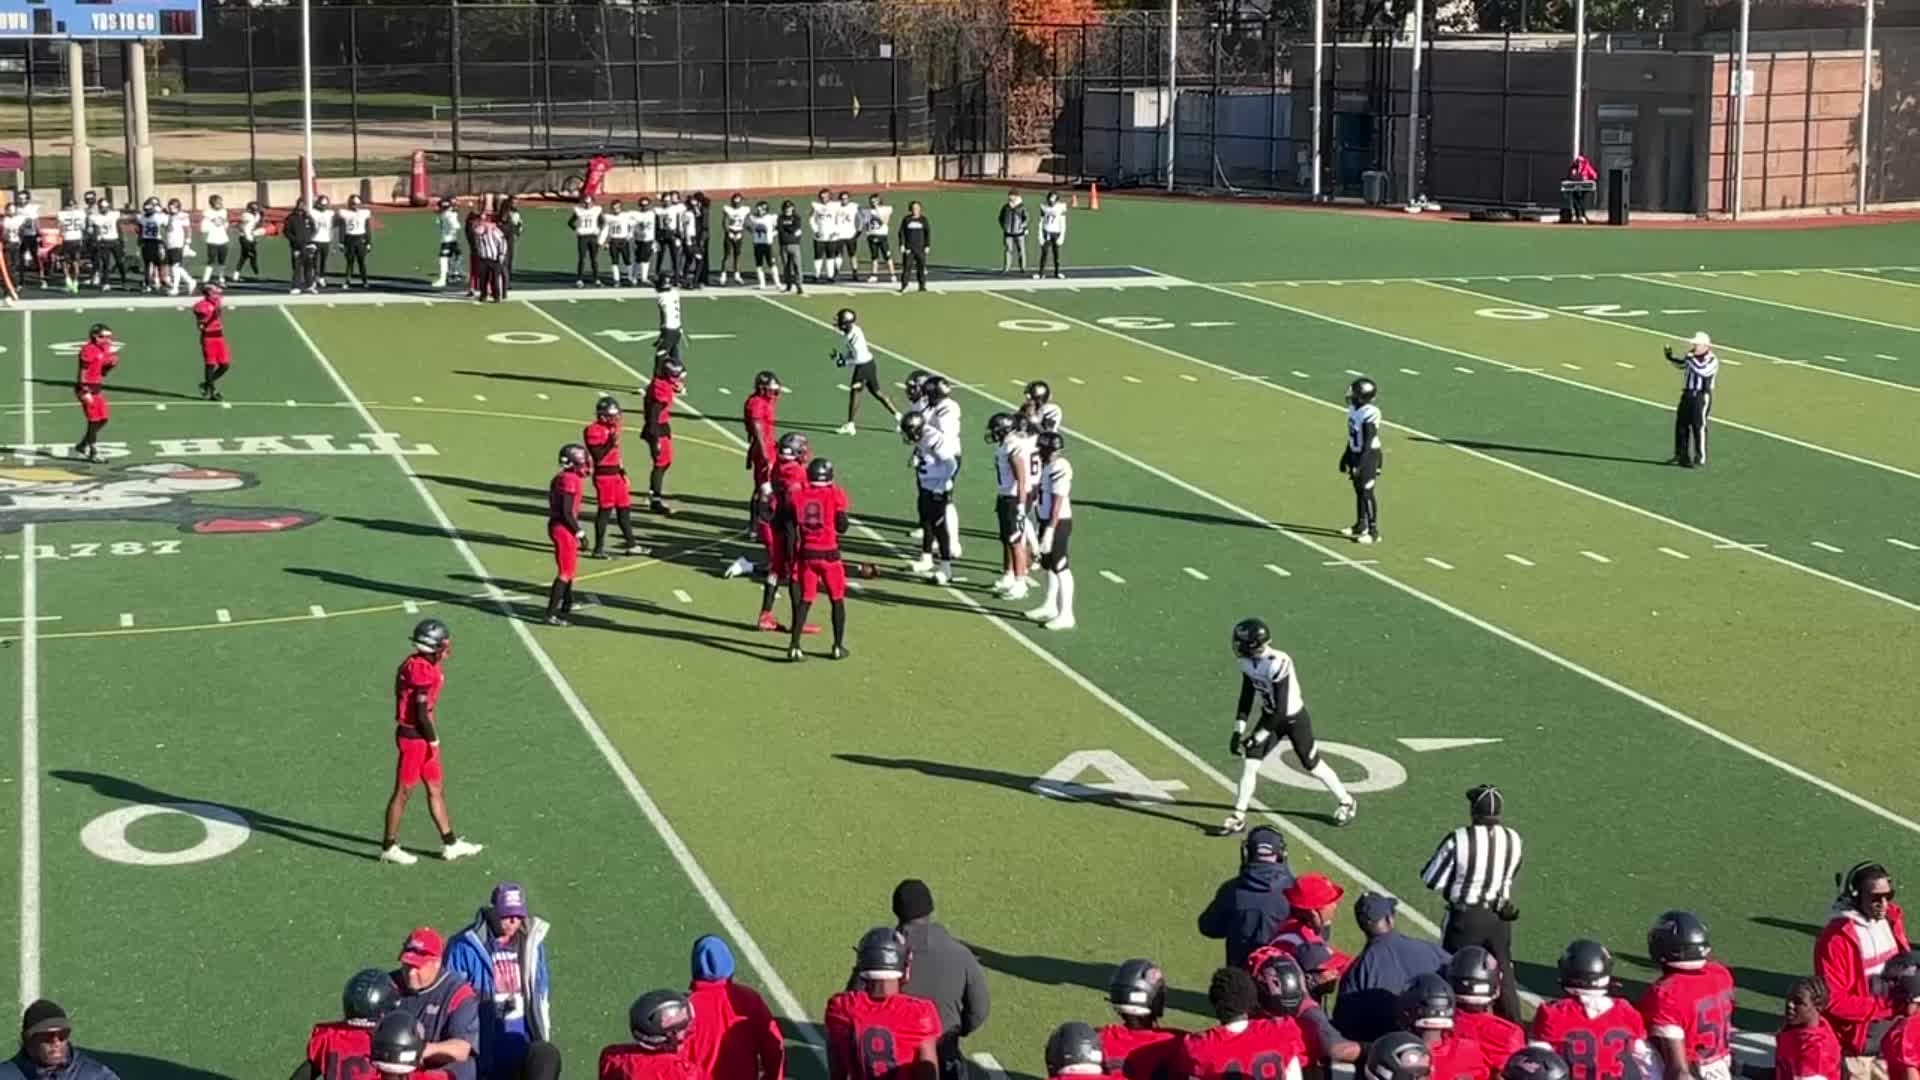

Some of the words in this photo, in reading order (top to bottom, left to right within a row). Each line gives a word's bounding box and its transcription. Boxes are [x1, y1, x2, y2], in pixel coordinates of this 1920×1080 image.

[91, 12, 118, 31] YDS
[119, 12, 135, 31] TO
[136, 12, 154, 31] GO
[149, 433, 440, 456] HALL
[32, 540, 183, 560] 1787
